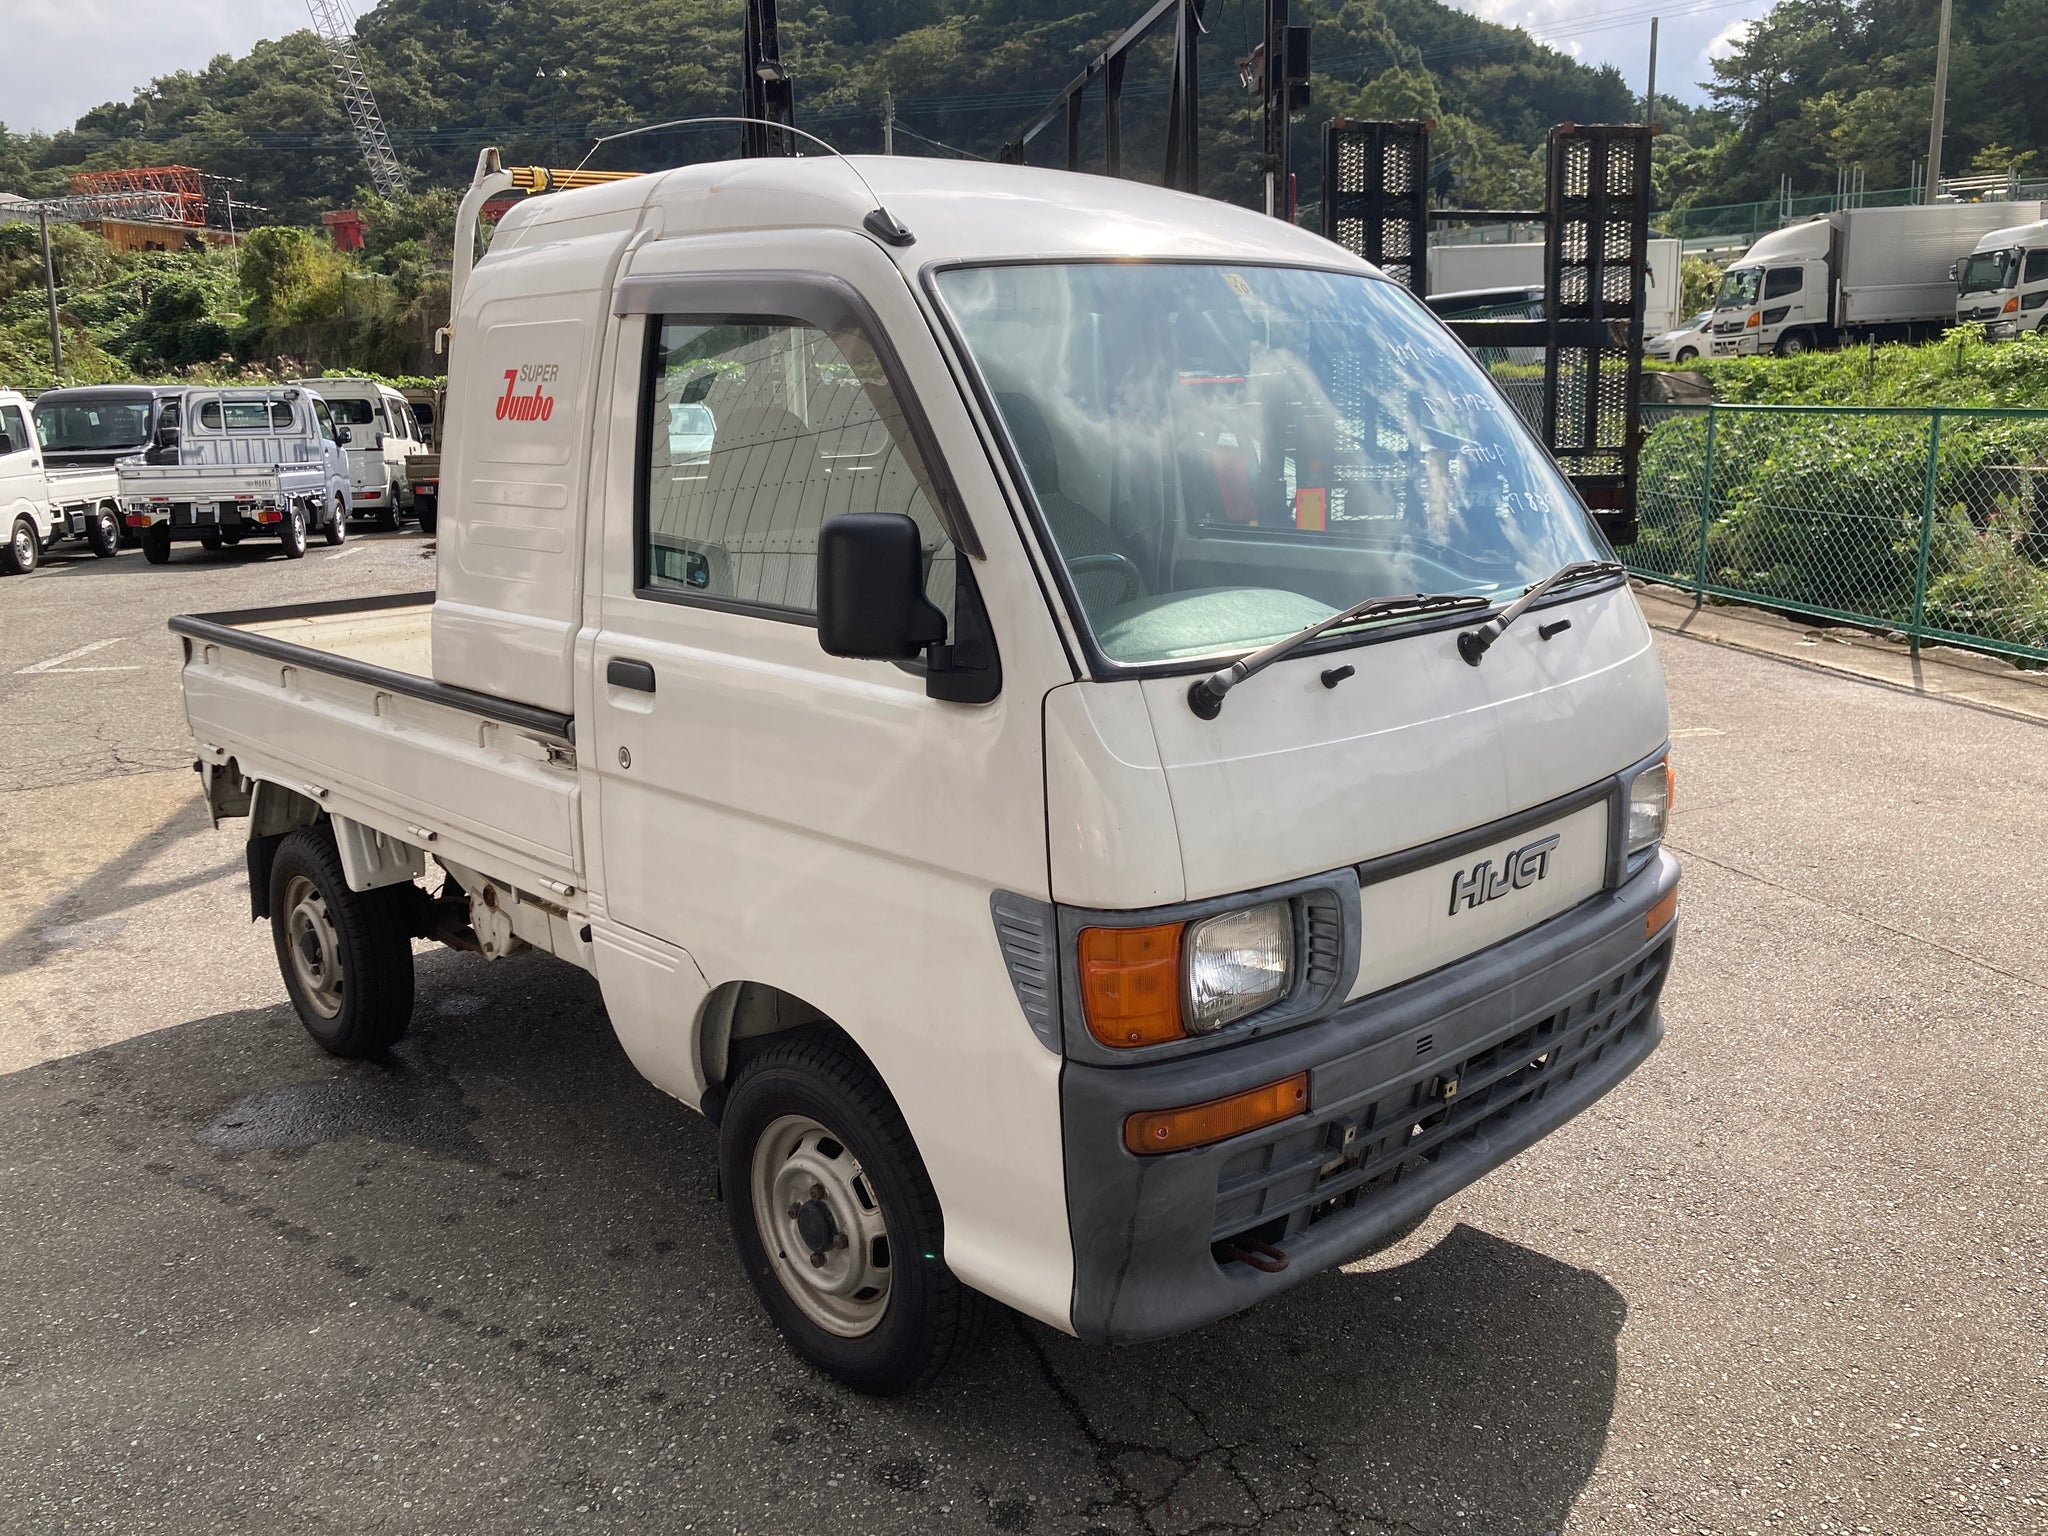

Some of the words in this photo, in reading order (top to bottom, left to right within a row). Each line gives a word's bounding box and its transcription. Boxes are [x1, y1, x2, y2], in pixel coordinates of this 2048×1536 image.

[495, 369, 554, 422] Jumbo
[519, 363, 559, 383] SUPER
[1448, 833, 1561, 917] HIJET
